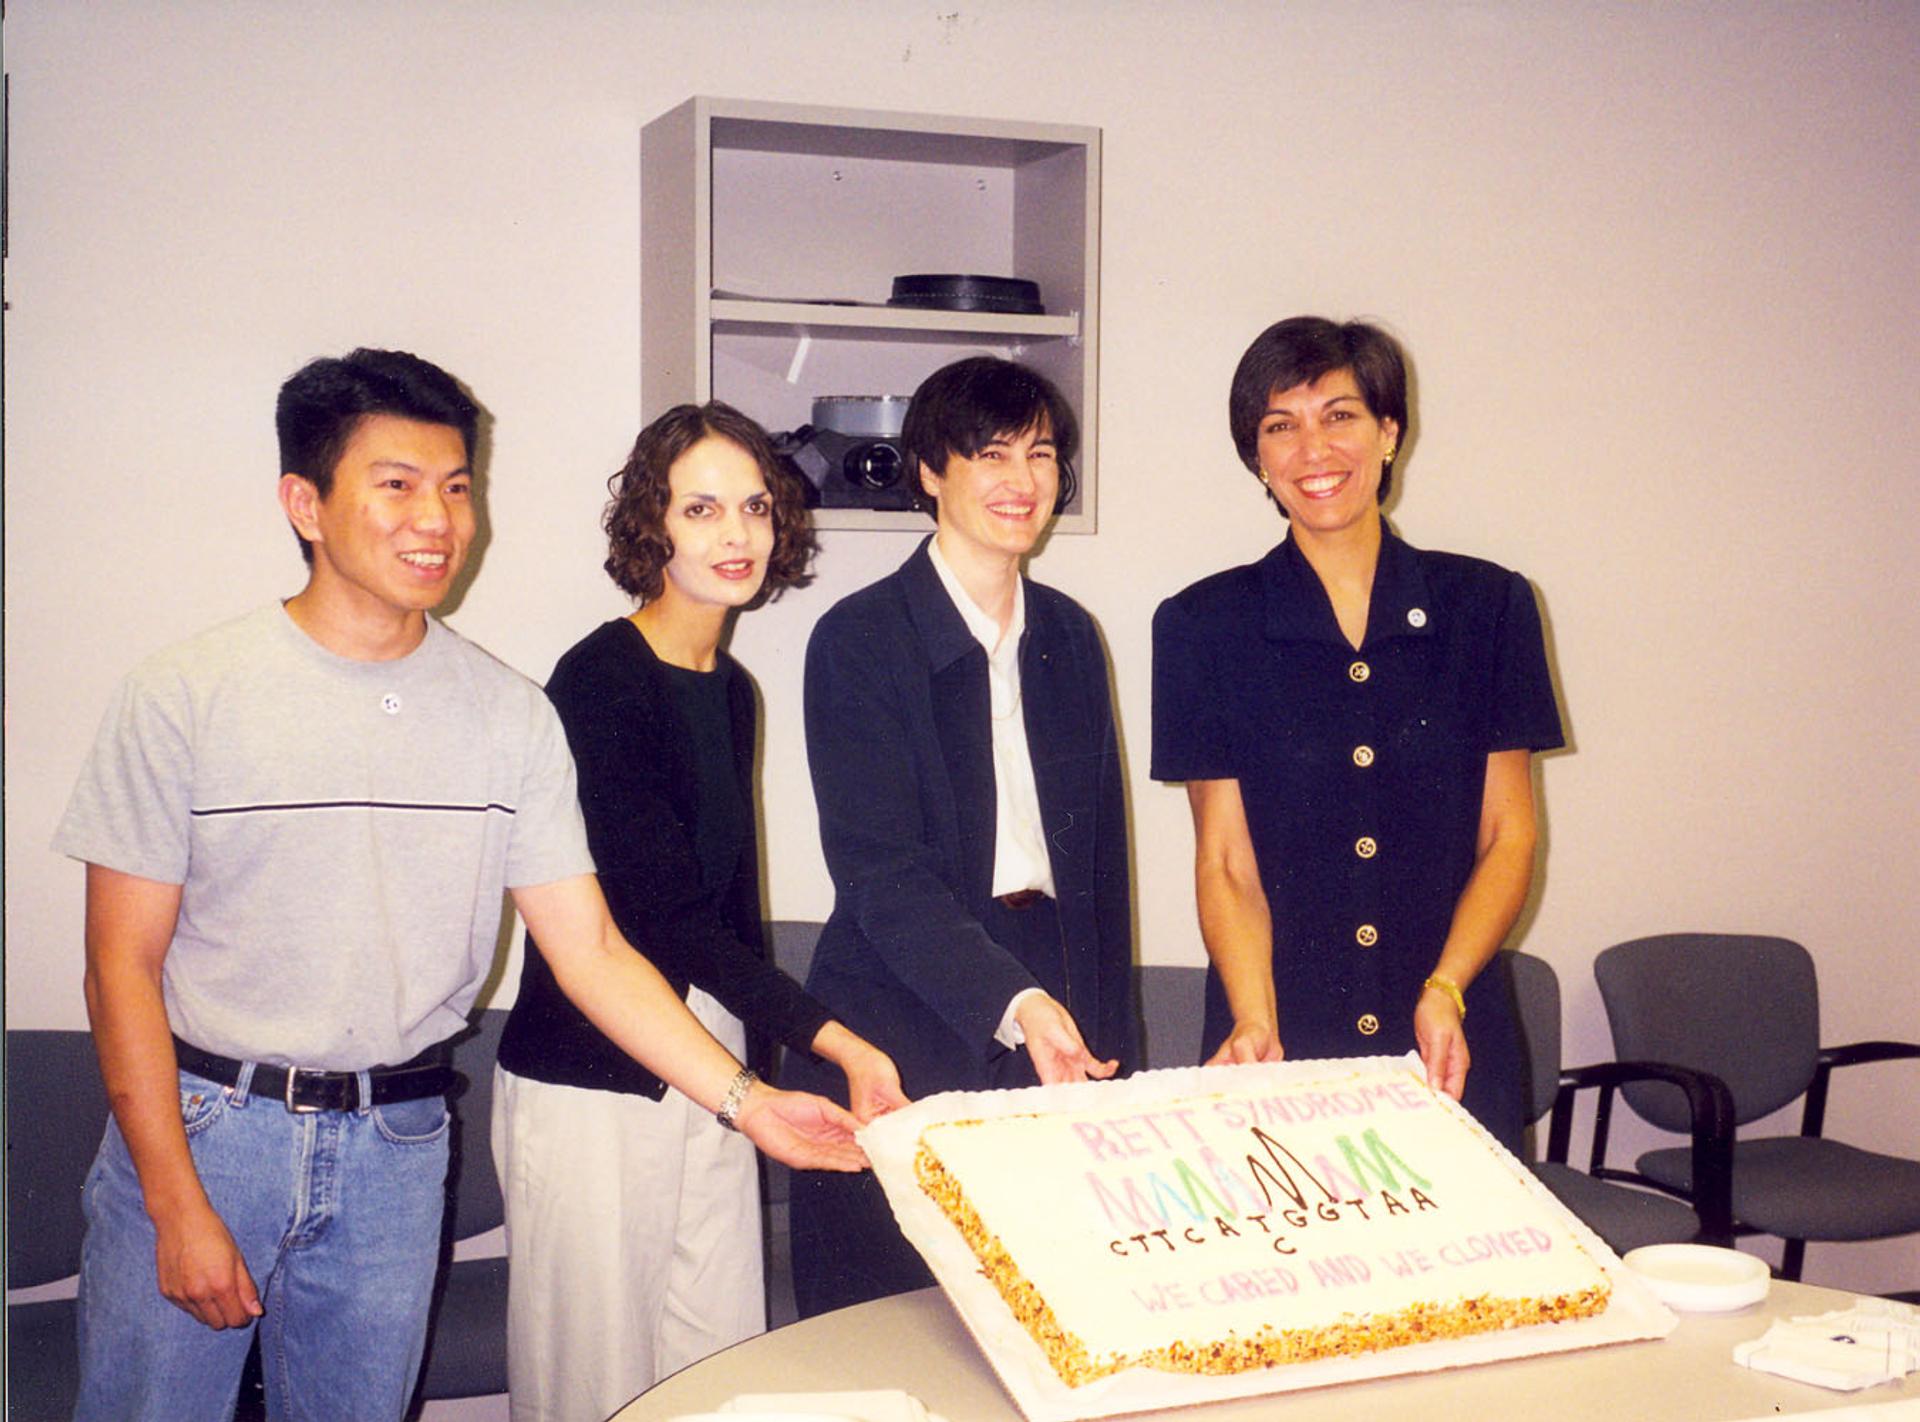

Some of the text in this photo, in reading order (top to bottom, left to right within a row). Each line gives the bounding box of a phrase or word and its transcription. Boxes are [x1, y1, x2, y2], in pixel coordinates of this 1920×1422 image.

[1072, 1082, 1430, 1162] RETT SYNDROME
[1131, 1226, 1552, 1314] WE CARED AND WE CLONED
